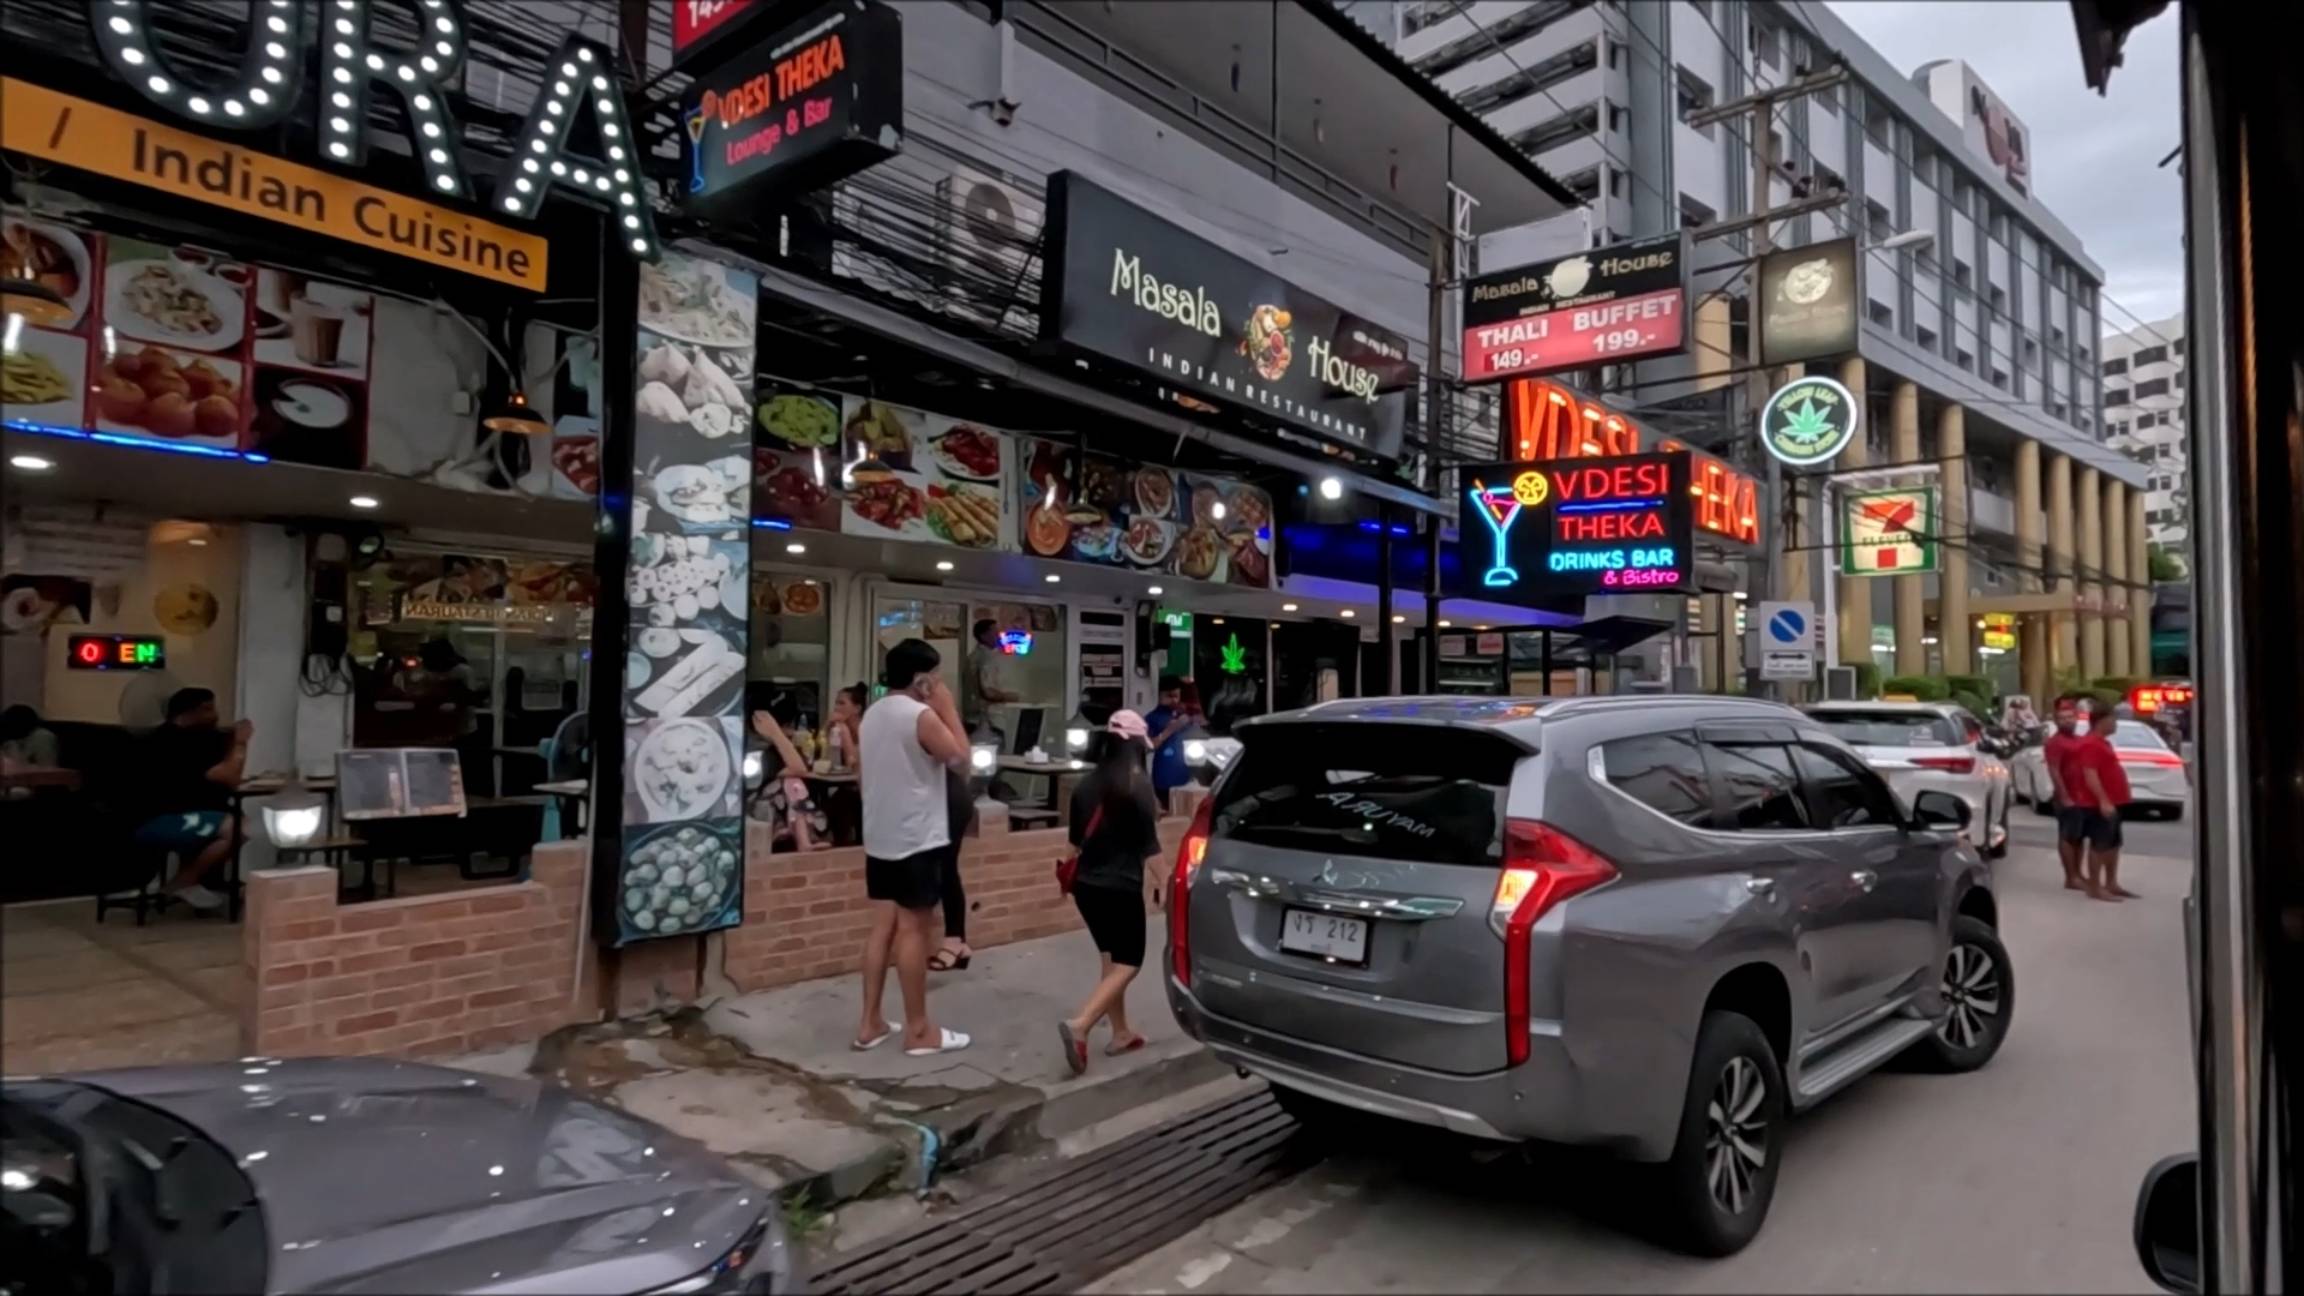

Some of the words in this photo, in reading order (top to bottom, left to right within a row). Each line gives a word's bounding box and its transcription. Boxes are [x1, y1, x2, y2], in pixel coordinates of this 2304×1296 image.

[718, 73, 770, 126] VDESI
[776, 34, 844, 101] THEKA
[727, 123, 780, 166] Lounge
[786, 108, 799, 136] &
[804, 97, 832, 128] Bar
[133, 129, 326, 222] Indian
[354, 196, 531, 279] Cuisine
[1472, 276, 1540, 302] Masala
[1600, 250, 1674, 277] House
[1111, 248, 1221, 337] Masala
[1308, 335, 1379, 405] House
[1477, 319, 1549, 349] THALI
[1572, 294, 1677, 332] BUFFET
[1490, 348, 1540, 371] 149.-
[1592, 328, 1657, 353] 199.-
[1149, 347, 1236, 393] INDIAN
[1246, 384, 1367, 441] RESTAURANT
[1553, 463, 1671, 500] VDESI
[1557, 513, 1665, 541] THEKA
[1549, 550, 1626, 572] DRINKS
[1632, 548, 1674, 568] BAR
[1603, 571, 1618, 585] &
[1622, 569, 1680, 586] Bistro
[1327, 919, 1358, 942] 212
